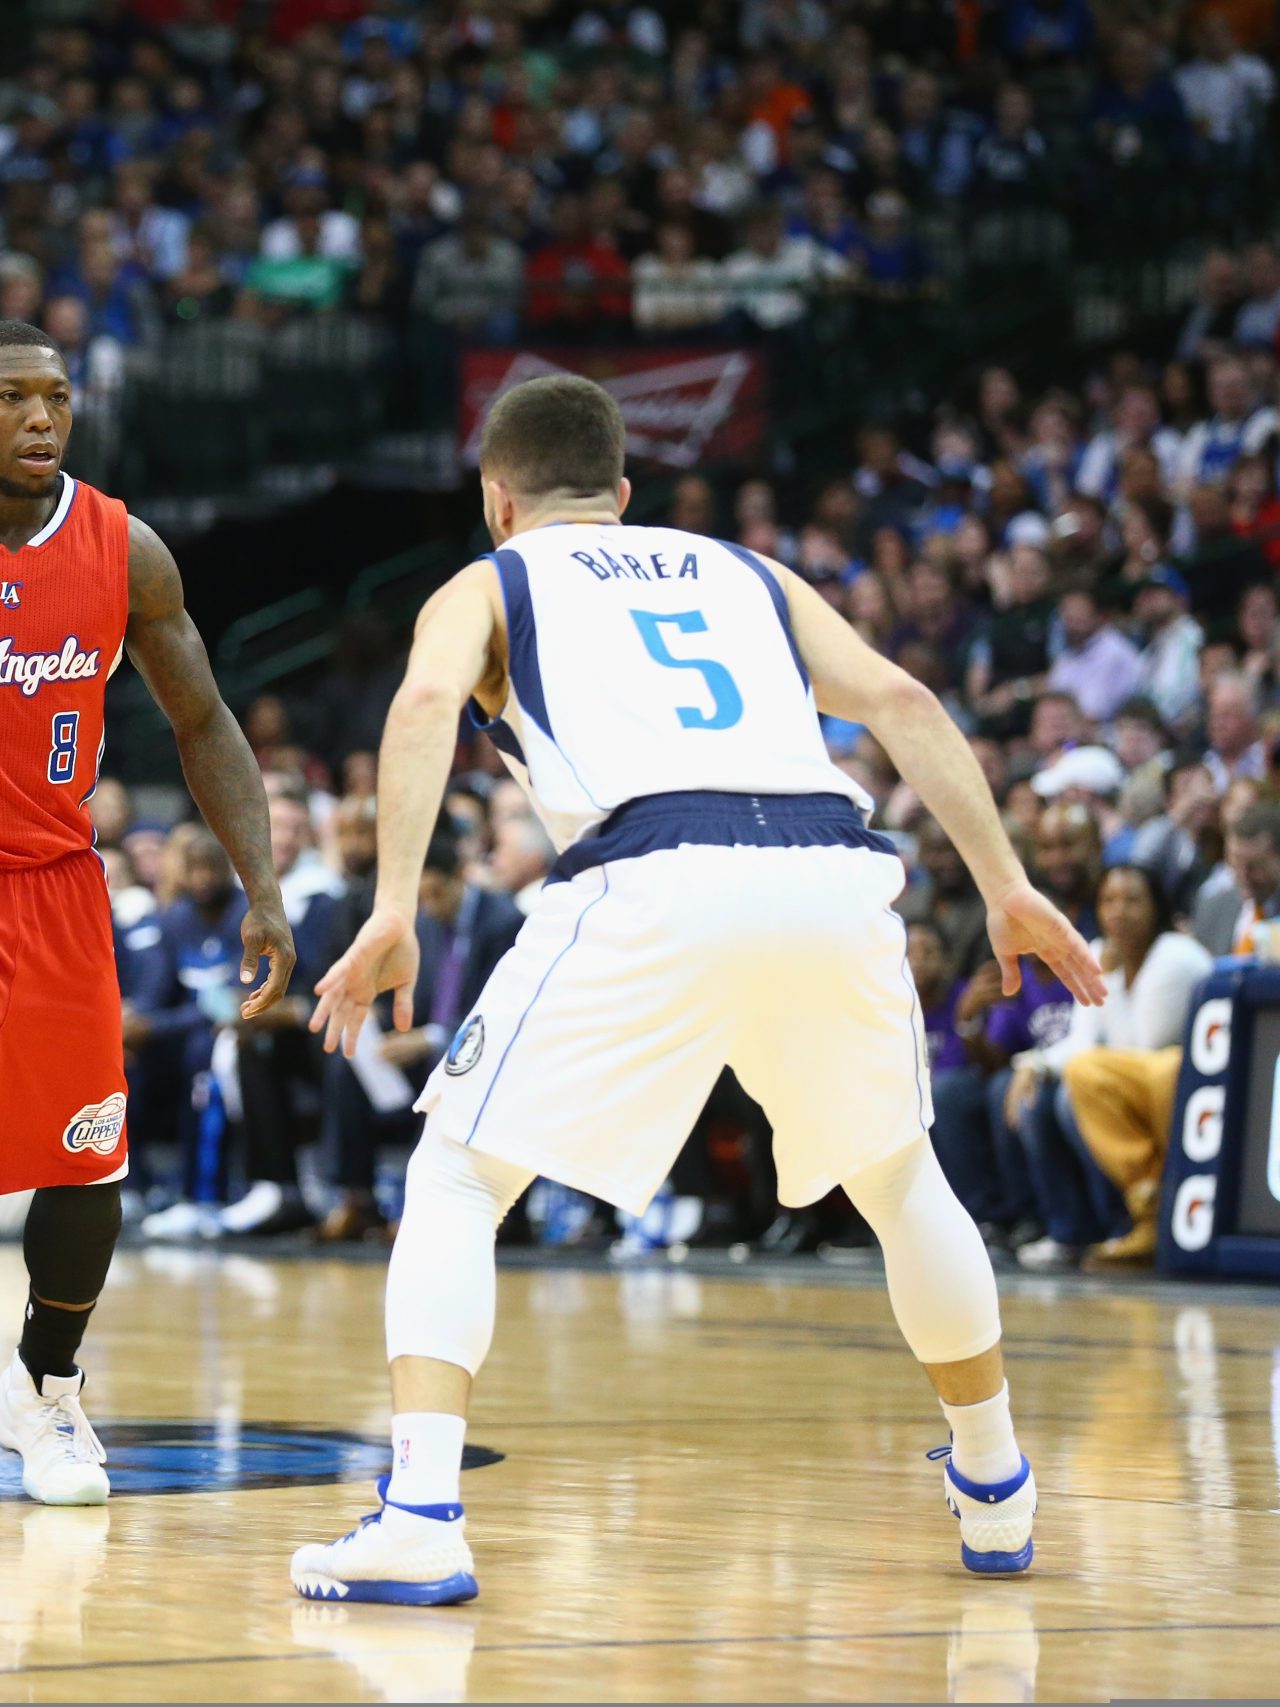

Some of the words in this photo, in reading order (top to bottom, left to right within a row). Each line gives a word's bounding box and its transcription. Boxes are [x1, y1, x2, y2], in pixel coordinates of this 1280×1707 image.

[570, 547, 699, 581] BAREA
[627, 608, 744, 731] 5
[47, 711, 80, 784] 8
[1190, 997, 1233, 1076] G
[1182, 1084, 1226, 1162] G
[1172, 1173, 1218, 1252] G
